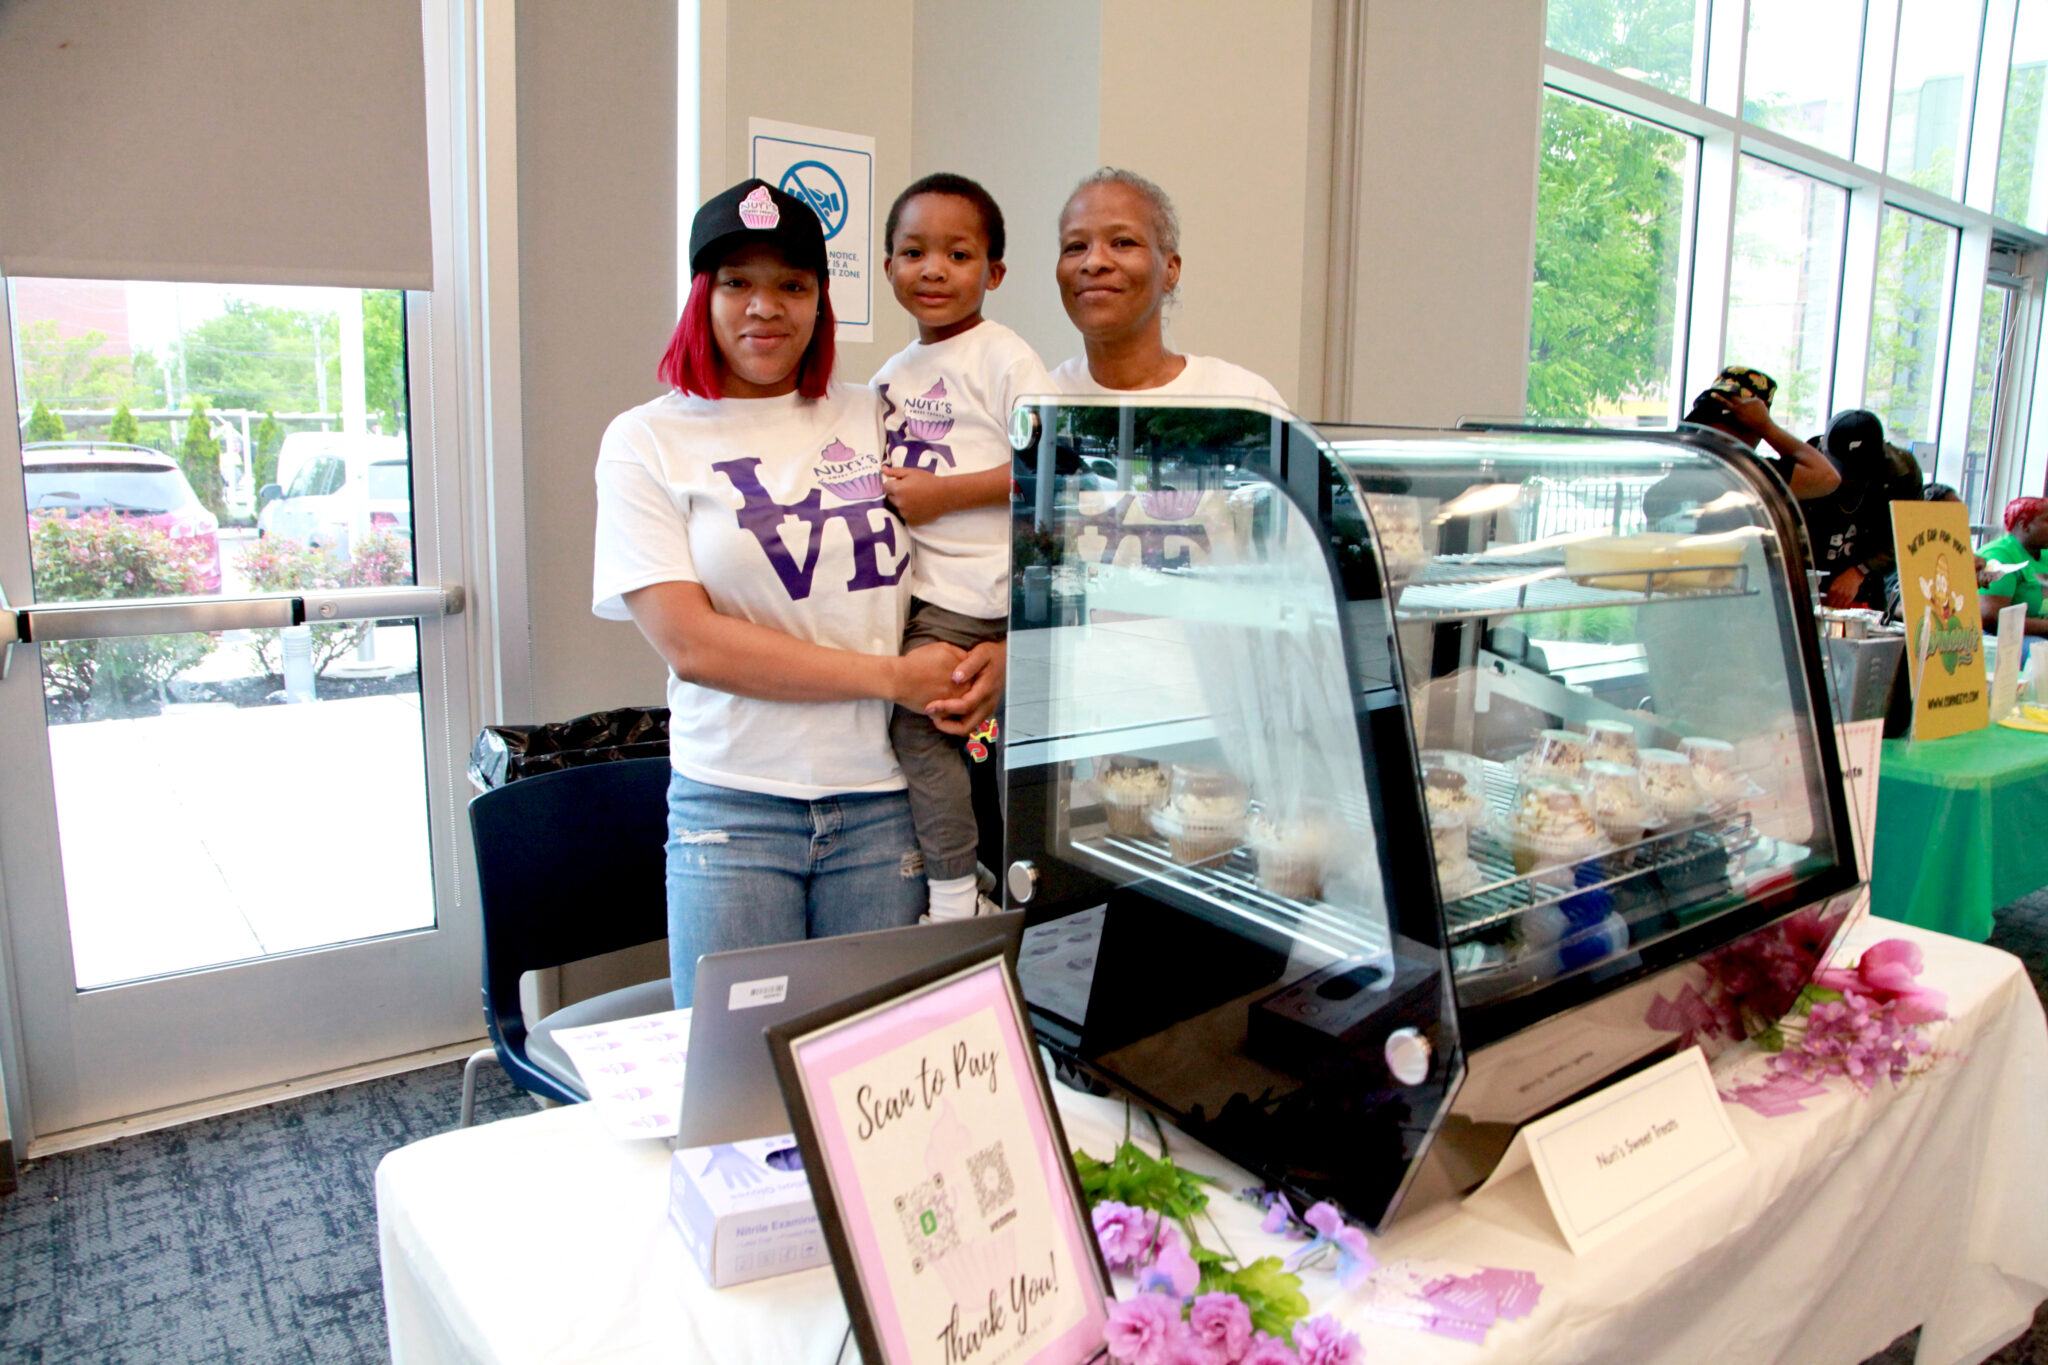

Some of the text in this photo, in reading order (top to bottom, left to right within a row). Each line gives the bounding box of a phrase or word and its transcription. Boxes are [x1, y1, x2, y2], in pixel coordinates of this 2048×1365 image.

[833, 260, 840, 268] IS
[839, 269, 860, 278] ZONE
[857, 1039, 1000, 1141] Scan to Pay
[1595, 1144, 1626, 1169] Nuri's
[1624, 1130, 1653, 1154] Sweet
[735, 1223, 769, 1238] Nitrile
[935, 1287, 1007, 1365] Thank
[1009, 1249, 1059, 1337] You!
